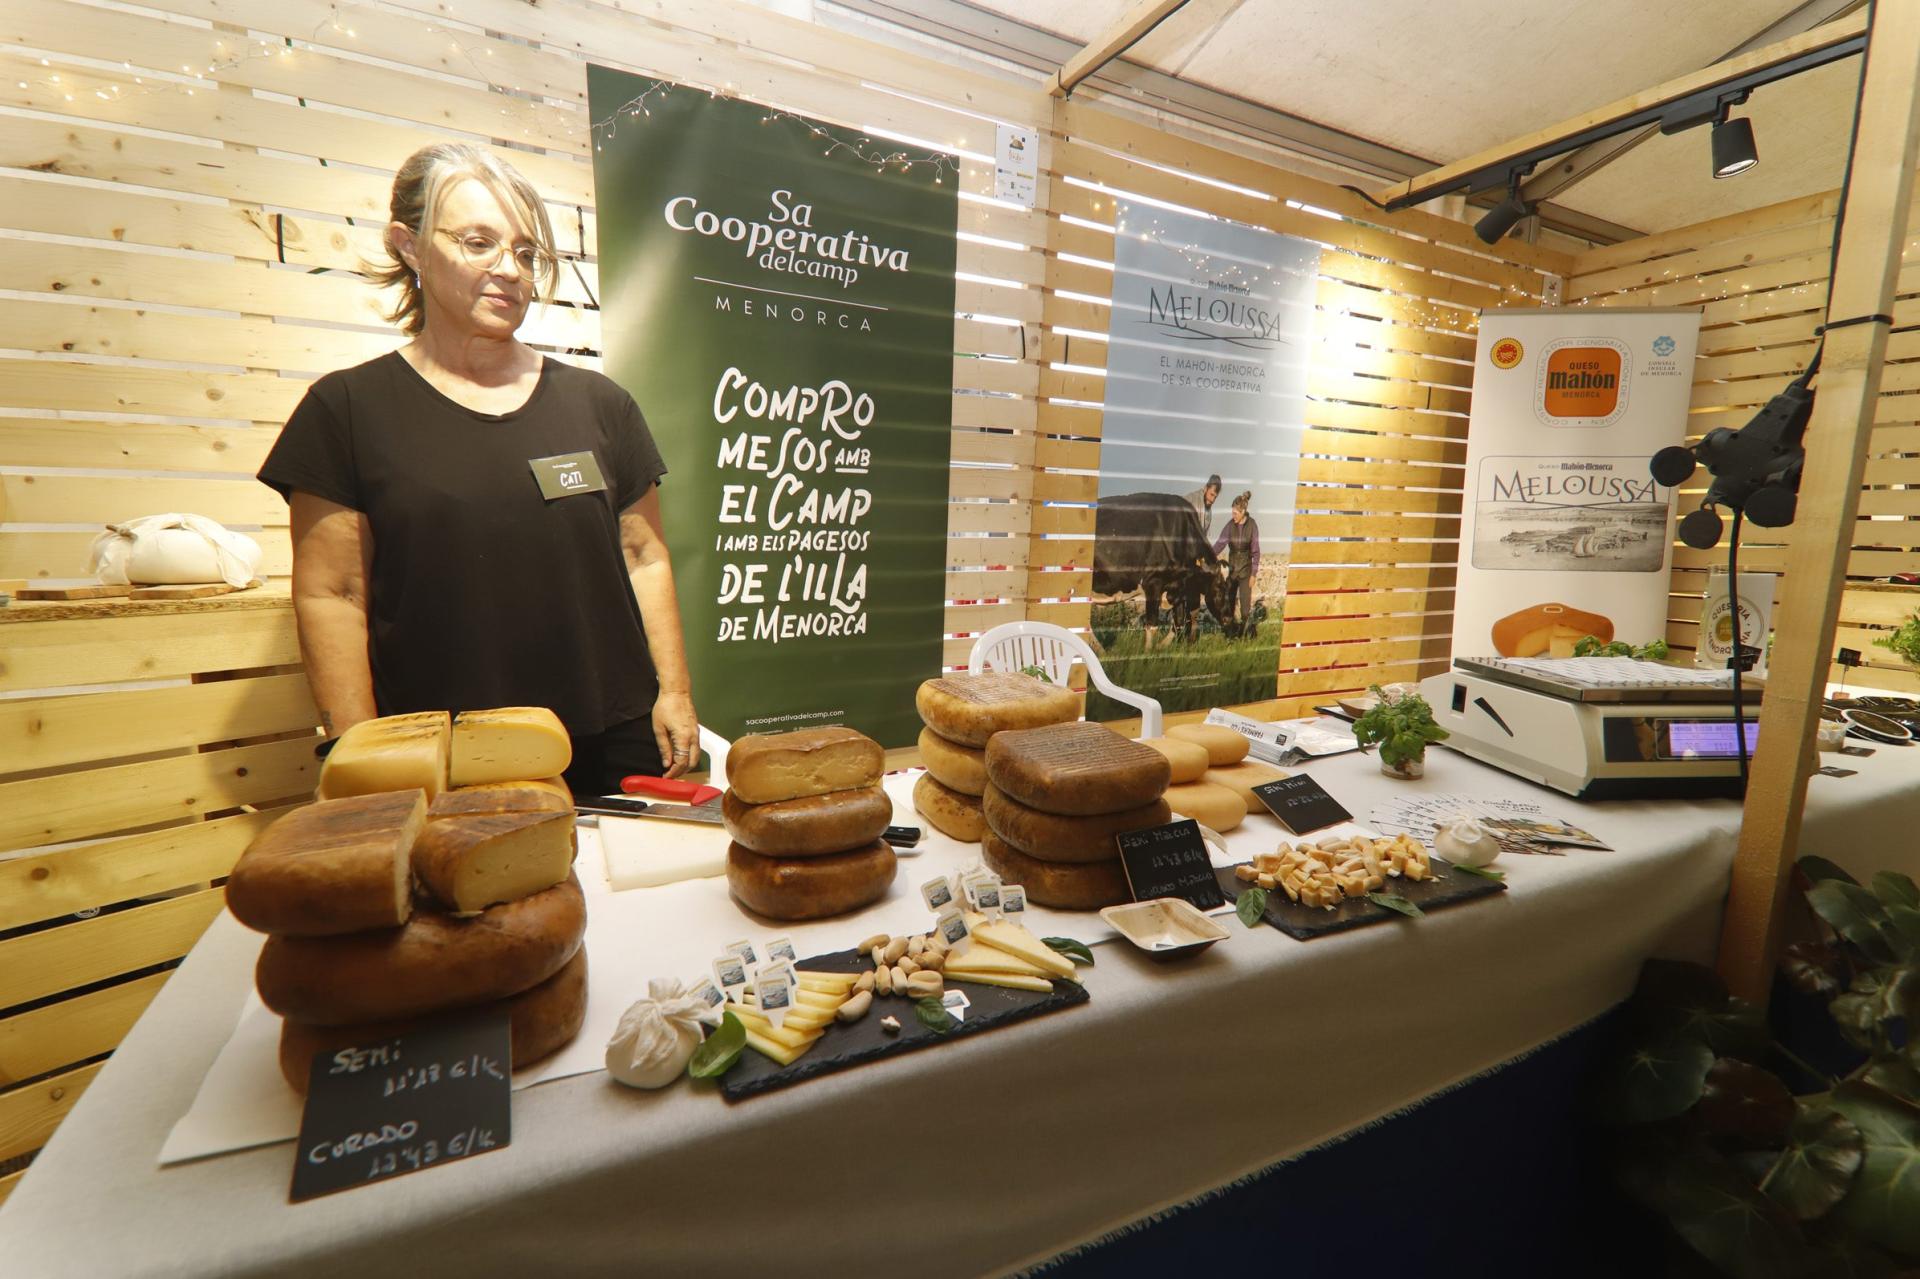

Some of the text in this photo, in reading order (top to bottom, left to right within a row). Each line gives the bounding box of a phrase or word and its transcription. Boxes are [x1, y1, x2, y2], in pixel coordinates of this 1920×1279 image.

[768, 190, 812, 227] Sa
[665, 196, 910, 272] Cooperativa
[759, 247, 858, 288] delcamp
[1150, 284, 1280, 341] MELOUSSA
[1160, 356, 1170, 368] EL
[1549, 371, 1615, 390] mahón
[1569, 362, 1600, 370] QUESO
[1162, 374, 1262, 393] DE SA COOPERATIVA
[714, 367, 875, 440] COMPRO
[717, 428, 871, 479] MESOS AMB
[719, 473, 872, 531] EL CAMP
[1493, 470, 1656, 503] MELOUSSA
[716, 530, 870, 551] I AMB ELS PAGESOS
[717, 563, 768, 604] DE
[717, 605, 867, 643] DE MENORCA
[1712, 603, 1750, 620] QUESRIA
[746, 710, 844, 725] sacooperativadelcamp.com
